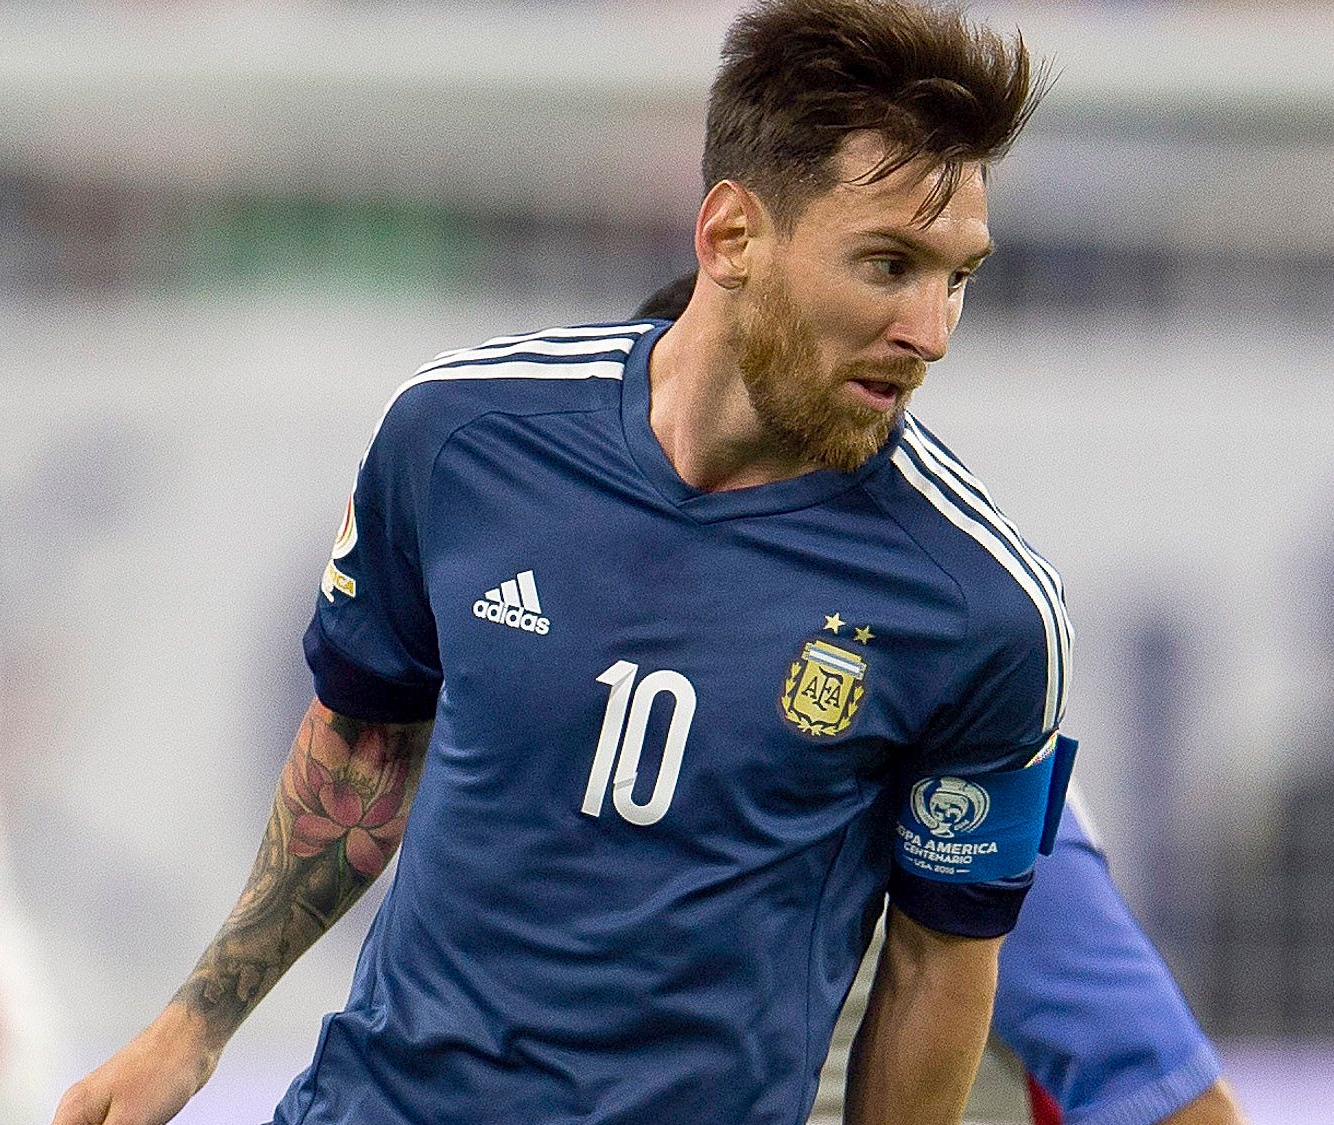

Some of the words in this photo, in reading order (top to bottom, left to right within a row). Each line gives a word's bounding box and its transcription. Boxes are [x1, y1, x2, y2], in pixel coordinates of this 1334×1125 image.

[472, 599, 551, 635] adidas
[801, 666, 844, 711] AFA
[581, 660, 696, 826] 10
[896, 821, 922, 847] OPA
[925, 840, 998, 855] AMERICA
[903, 841, 973, 864] CENTENARIO
